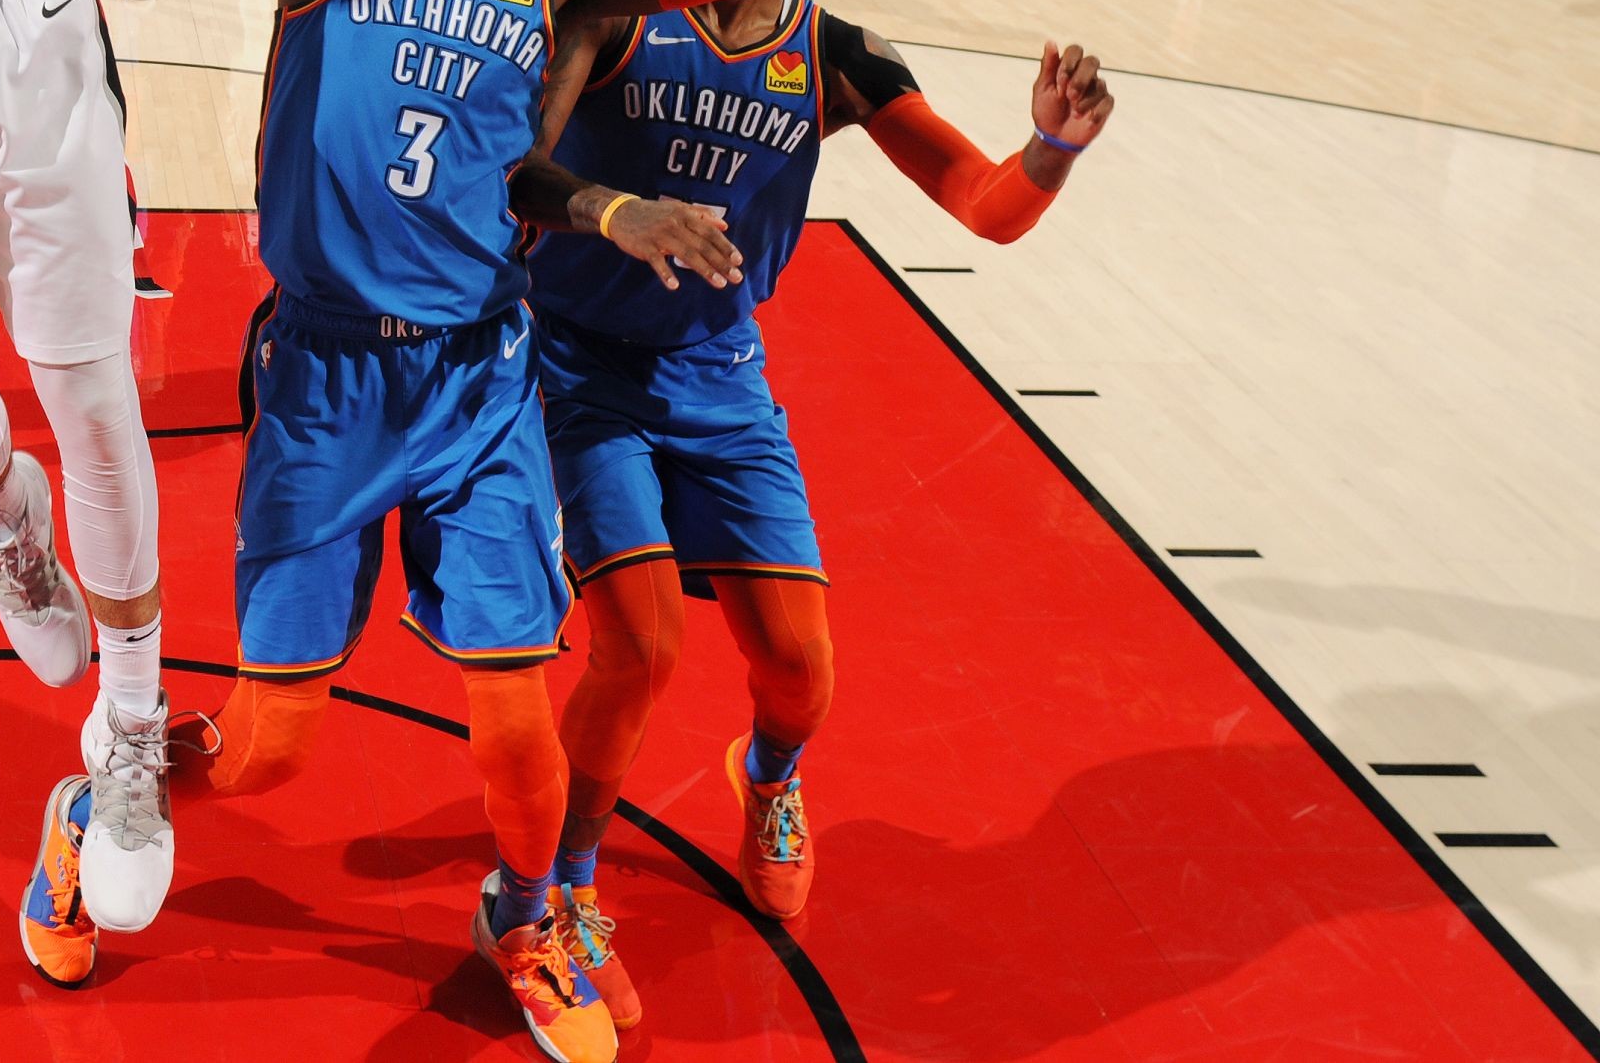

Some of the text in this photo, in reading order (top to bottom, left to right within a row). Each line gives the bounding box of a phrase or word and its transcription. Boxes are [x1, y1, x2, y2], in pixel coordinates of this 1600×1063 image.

[393, 39, 485, 101] CITY
[623, 81, 810, 154] OKLAHOMA
[386, 106, 447, 202] 3
[665, 137, 749, 186] CITY
